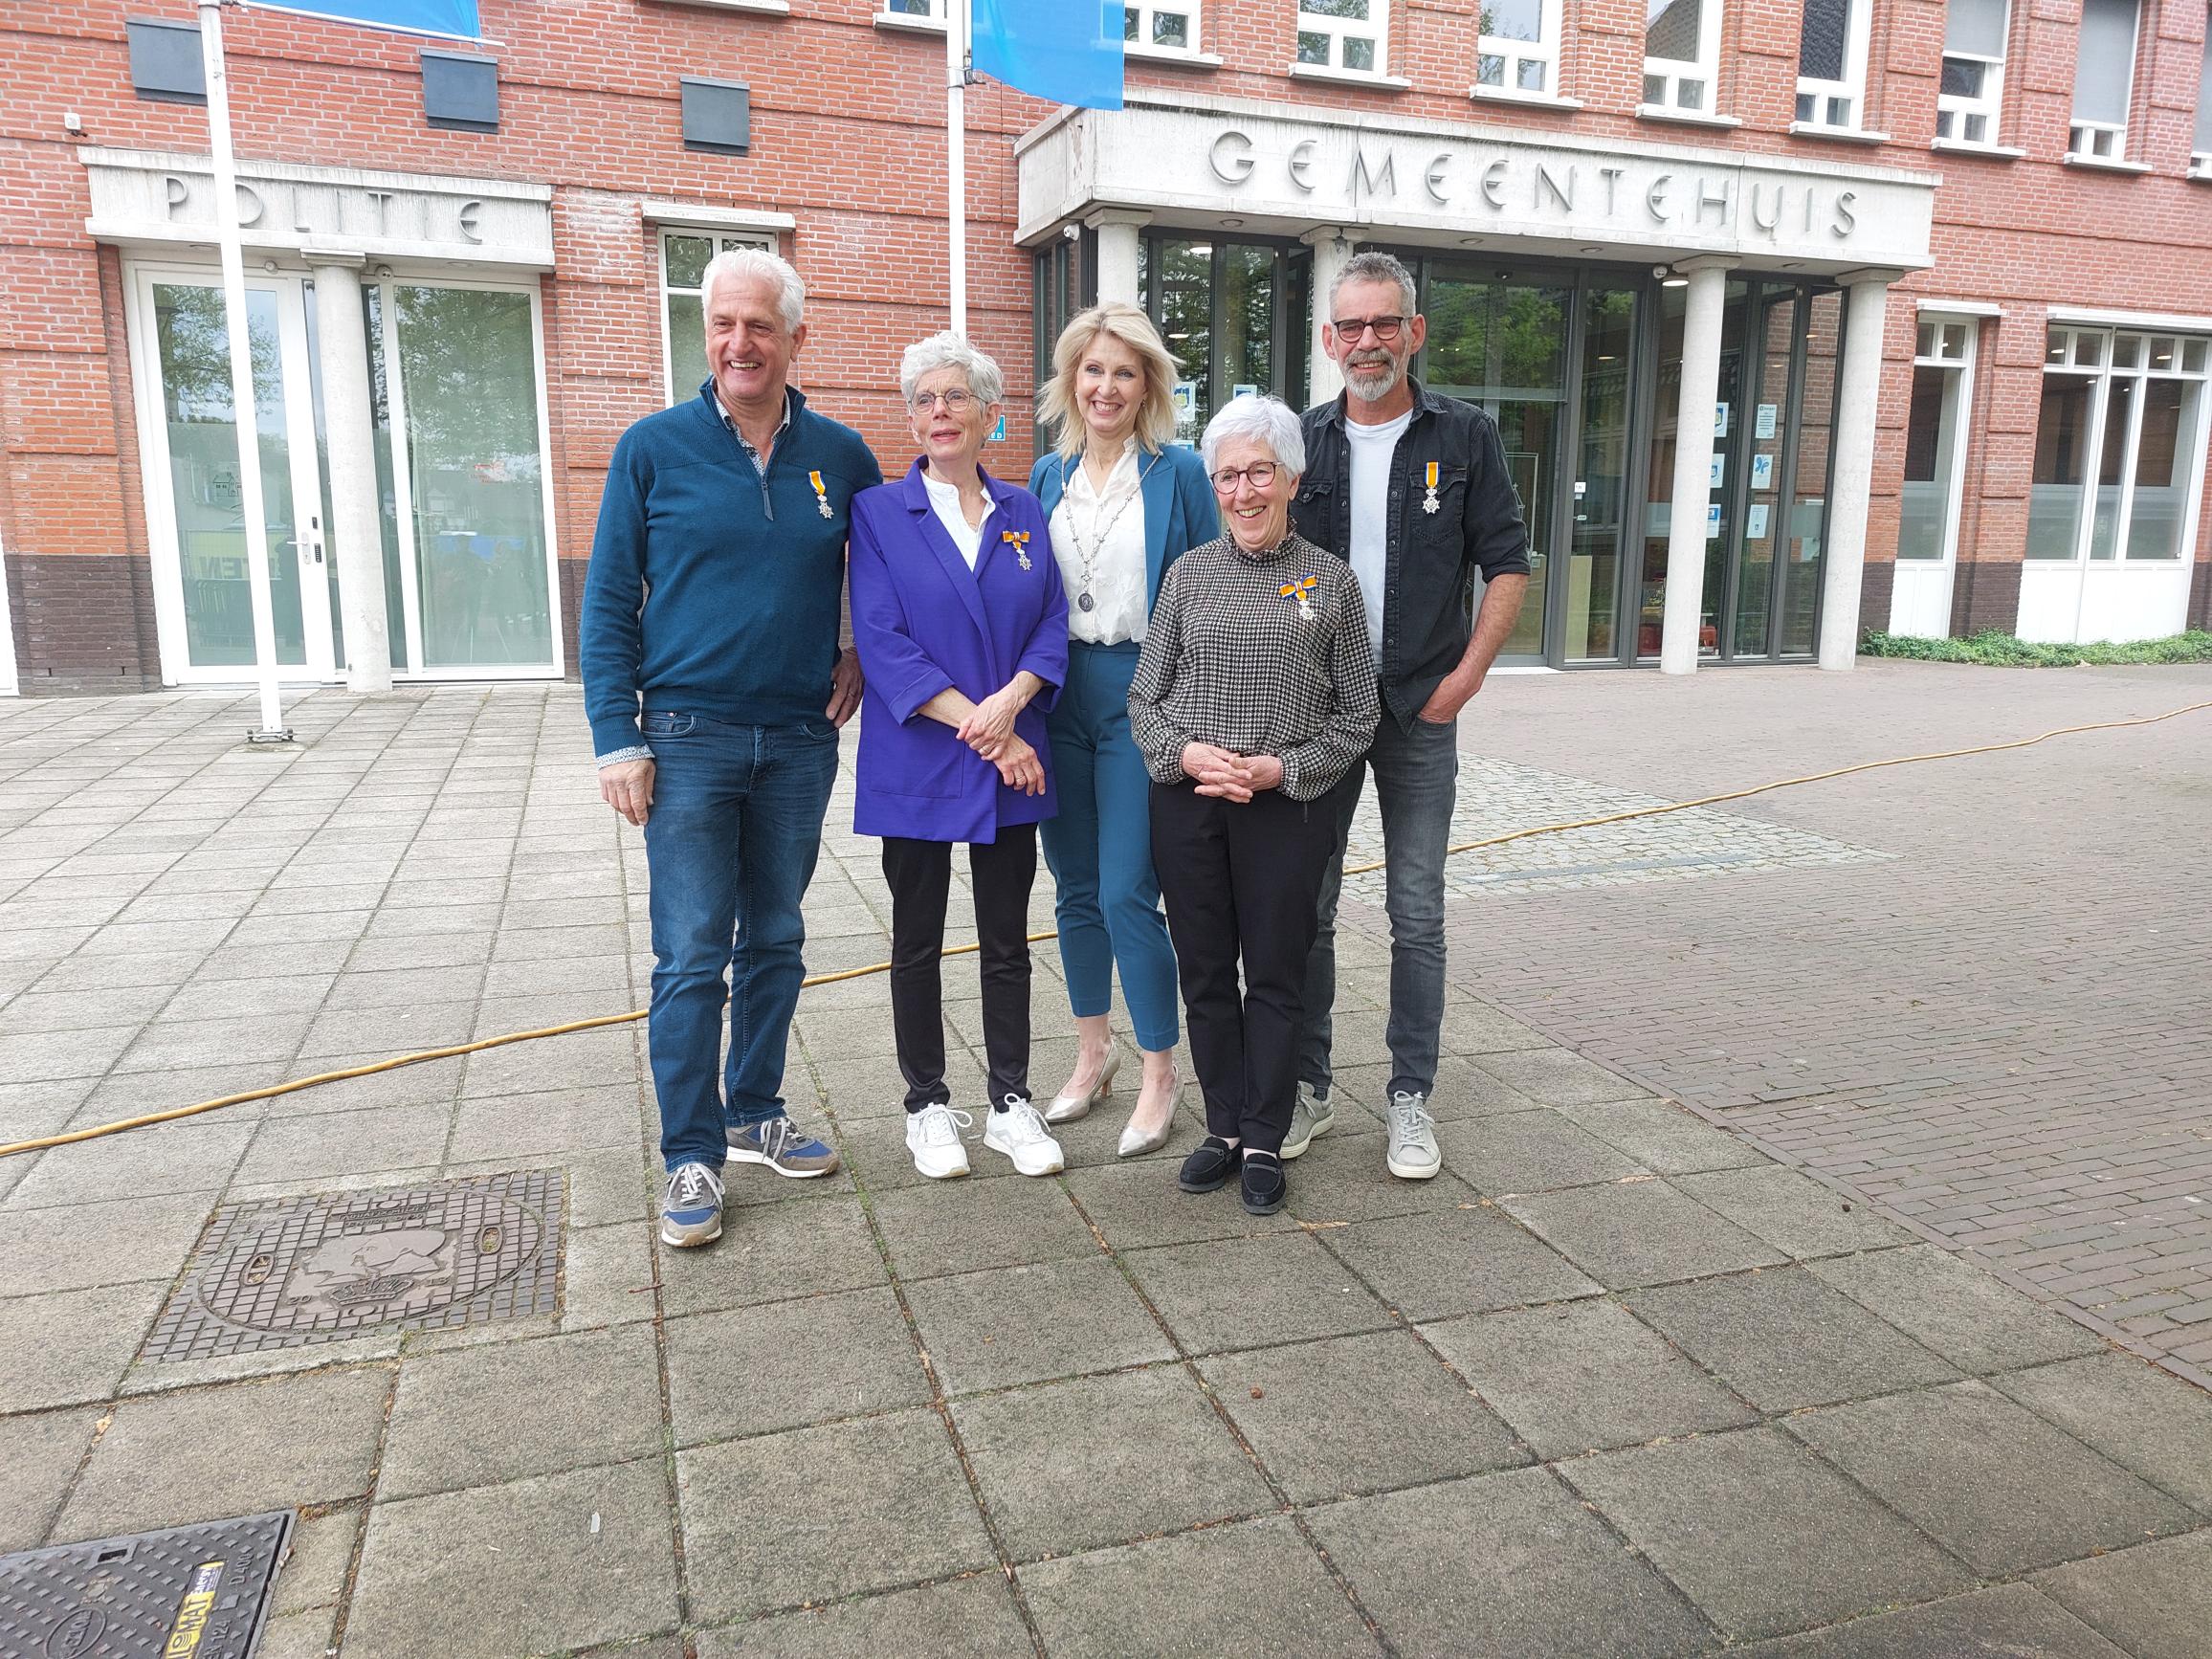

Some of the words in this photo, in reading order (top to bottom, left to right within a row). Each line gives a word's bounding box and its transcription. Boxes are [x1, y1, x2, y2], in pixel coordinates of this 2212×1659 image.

[166, 175, 482, 242] POLITIE
[1207, 130, 1857, 237] GEMEENTEHUIS
[210, 1620, 232, 1642] 124
